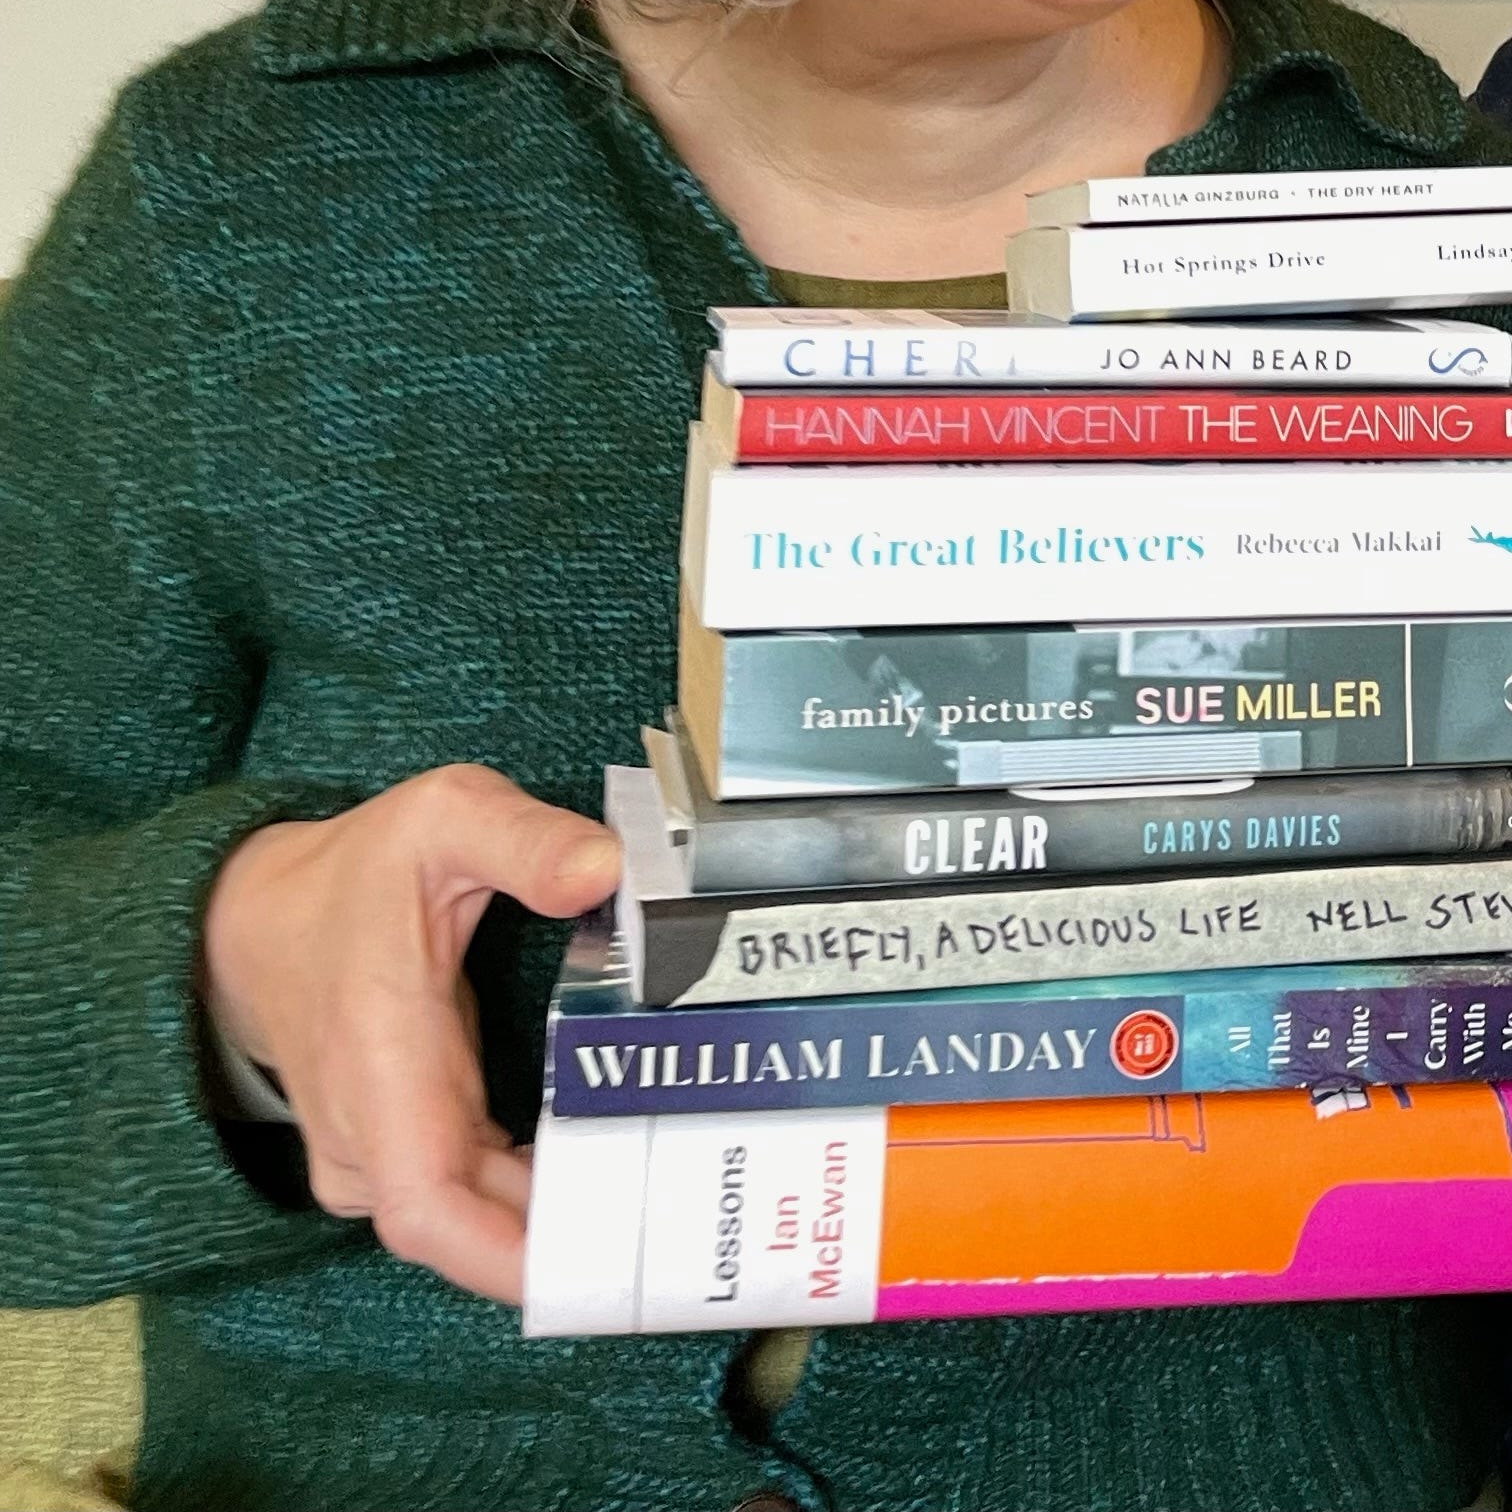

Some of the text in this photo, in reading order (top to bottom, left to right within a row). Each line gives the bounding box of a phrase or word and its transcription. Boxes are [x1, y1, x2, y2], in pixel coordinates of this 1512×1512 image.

[1117, 183, 1434, 207] NATALIA GINZBURG THE DRY HEART
[1122, 258, 1164, 275] Hot
[1174, 254, 1258, 277] Springs
[1268, 251, 1326, 269] Drive
[1100, 348, 1140, 370] JO
[1160, 348, 1232, 370] ANN
[1252, 347, 1352, 370] BEARD
[766, 403, 1474, 446] HANNAH VINCENT THE WEANING
[744, 526, 1442, 570] The Great Believers Rebecca Makkai
[799, 680, 1382, 738] family pictures SUE MILLER
[905, 814, 1049, 876] CLEAR
[1142, 818, 1232, 855] CARYS
[1245, 813, 1342, 850] DAVIES
[738, 925, 926, 977] BRIEFLY,
[935, 920, 960, 959] A
[968, 908, 1157, 955] DELICIOUS
[1179, 899, 1263, 938] LIFE
[1306, 899, 1408, 933] NELL
[574, 1027, 1099, 1088] WILLIAM LANDAY
[1227, 1025, 1251, 1058] All
[1266, 1011, 1293, 1071] That
[1307, 1026, 1331, 1051] Is
[1346, 1004, 1371, 1070] Mine
[1386, 1031, 1409, 1040] I
[1424, 998, 1453, 1071] Carry
[1462, 1002, 1486, 1065] With
[704, 1145, 748, 1304] Lessons
[765, 1194, 801, 1252] Ian
[807, 1141, 849, 1299] McEwan
